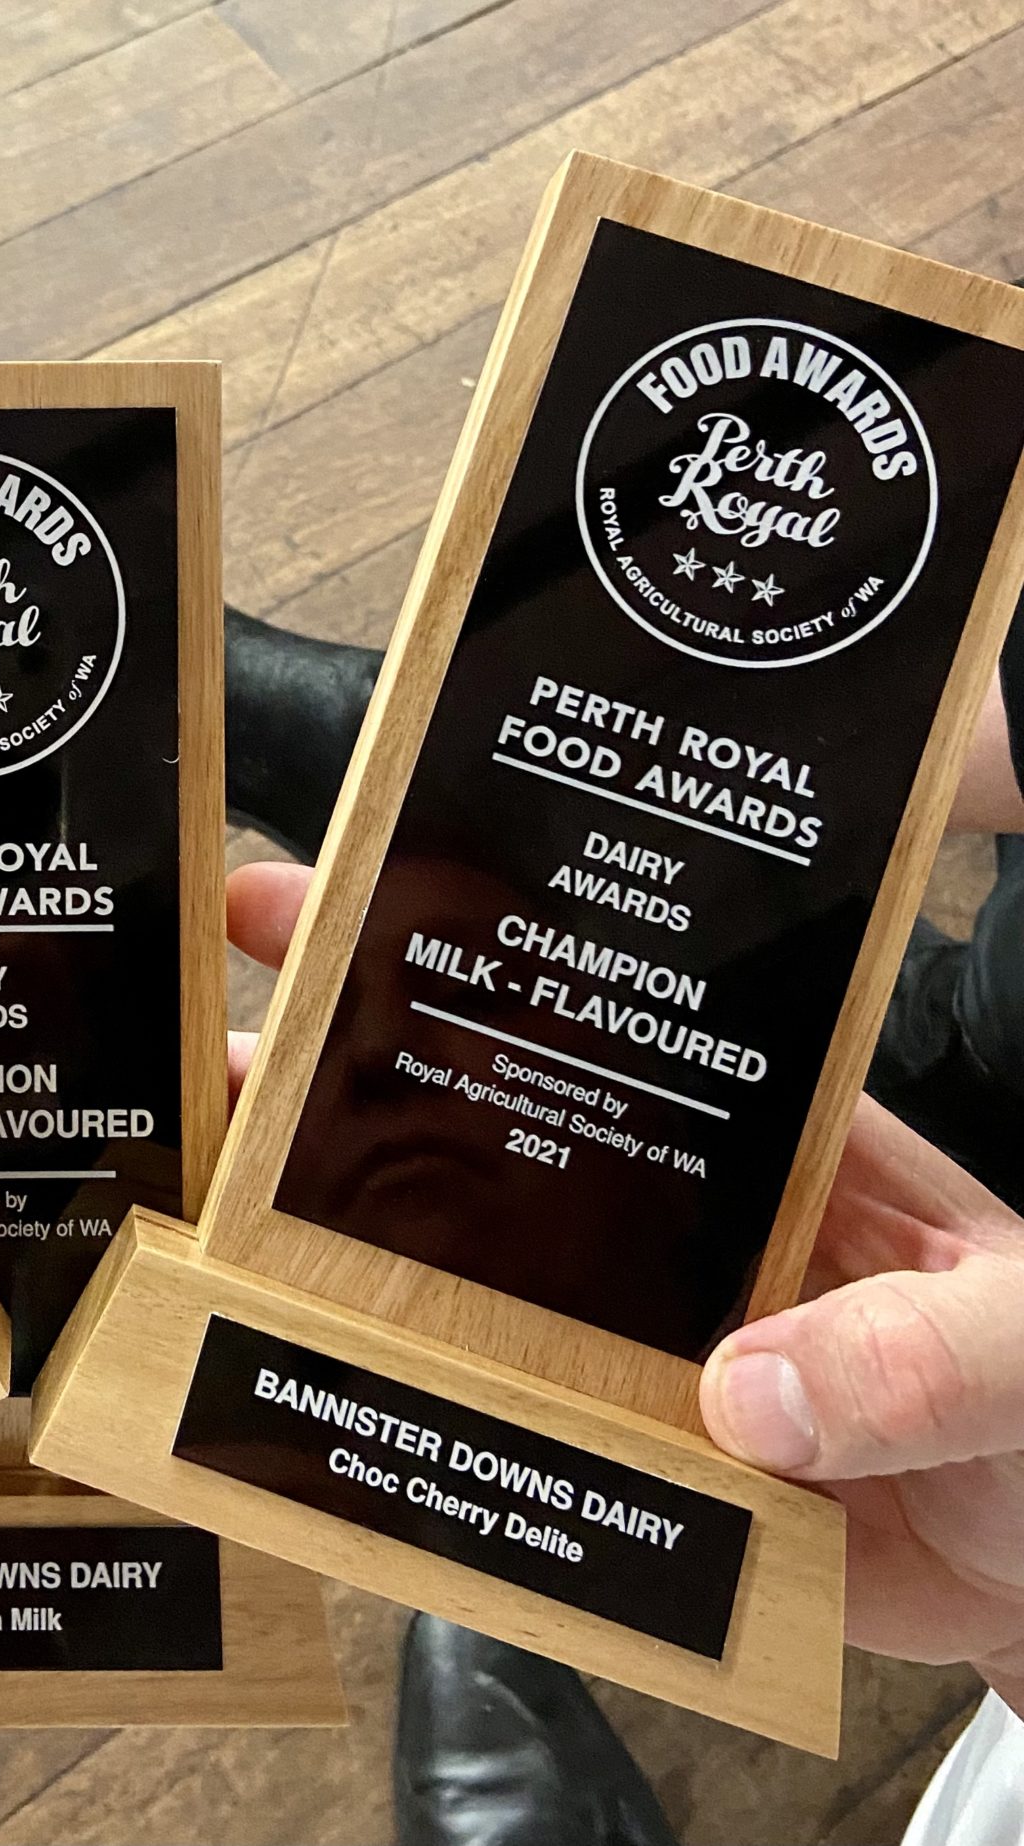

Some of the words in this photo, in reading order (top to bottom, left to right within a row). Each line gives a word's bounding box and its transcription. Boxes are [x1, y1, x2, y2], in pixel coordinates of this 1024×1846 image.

[636, 336, 751, 415] FOOD
[759, 336, 917, 481] AWARDS
[697, 412, 834, 500] Perth
[658, 453, 841, 548] Royal
[599, 487, 626, 551] ROYAL
[616, 555, 745, 644] AGRICULTURAL
[752, 613, 834, 645] SOCIETY
[841, 597, 858, 618] of
[854, 576, 885, 603] WA
[69, 683, 82, 700] of
[74, 653, 97, 680] WA
[497, 714, 622, 779] FOOD
[634, 764, 823, 848] AWARDS
[529, 676, 665, 746] PERTH
[678, 726, 815, 798] ROYAL
[548, 864, 691, 932] AWARDS
[583, 831, 685, 885] DAIRY
[496, 914, 706, 1011] CHAMPION
[404, 932, 503, 992] MILK
[507, 982, 522, 993] -
[529, 976, 767, 1083] FLAVOURED
[395, 1051, 452, 1087] Royal
[453, 1074, 567, 1127] Agricultural
[568, 1114, 644, 1159] Society
[647, 1141, 670, 1164] of
[673, 1149, 707, 1179] WA
[492, 1054, 600, 1107] Sponsored
[603, 1093, 628, 1120] by
[504, 1128, 572, 1169] 2021
[6, 1190, 27, 1212] by
[56, 1219, 74, 1237] of
[79, 1218, 113, 1237] WA
[253, 1368, 443, 1462] BANNISTER
[448, 1440, 575, 1511] DOWNS
[581, 1491, 684, 1551] DAIRY
[328, 1448, 400, 1494] Choc
[406, 1476, 500, 1537] Cherry
[504, 1512, 584, 1563] Delite
[11, 1607, 63, 1631] Milk
[70, 1561, 162, 1589] DAIRY
